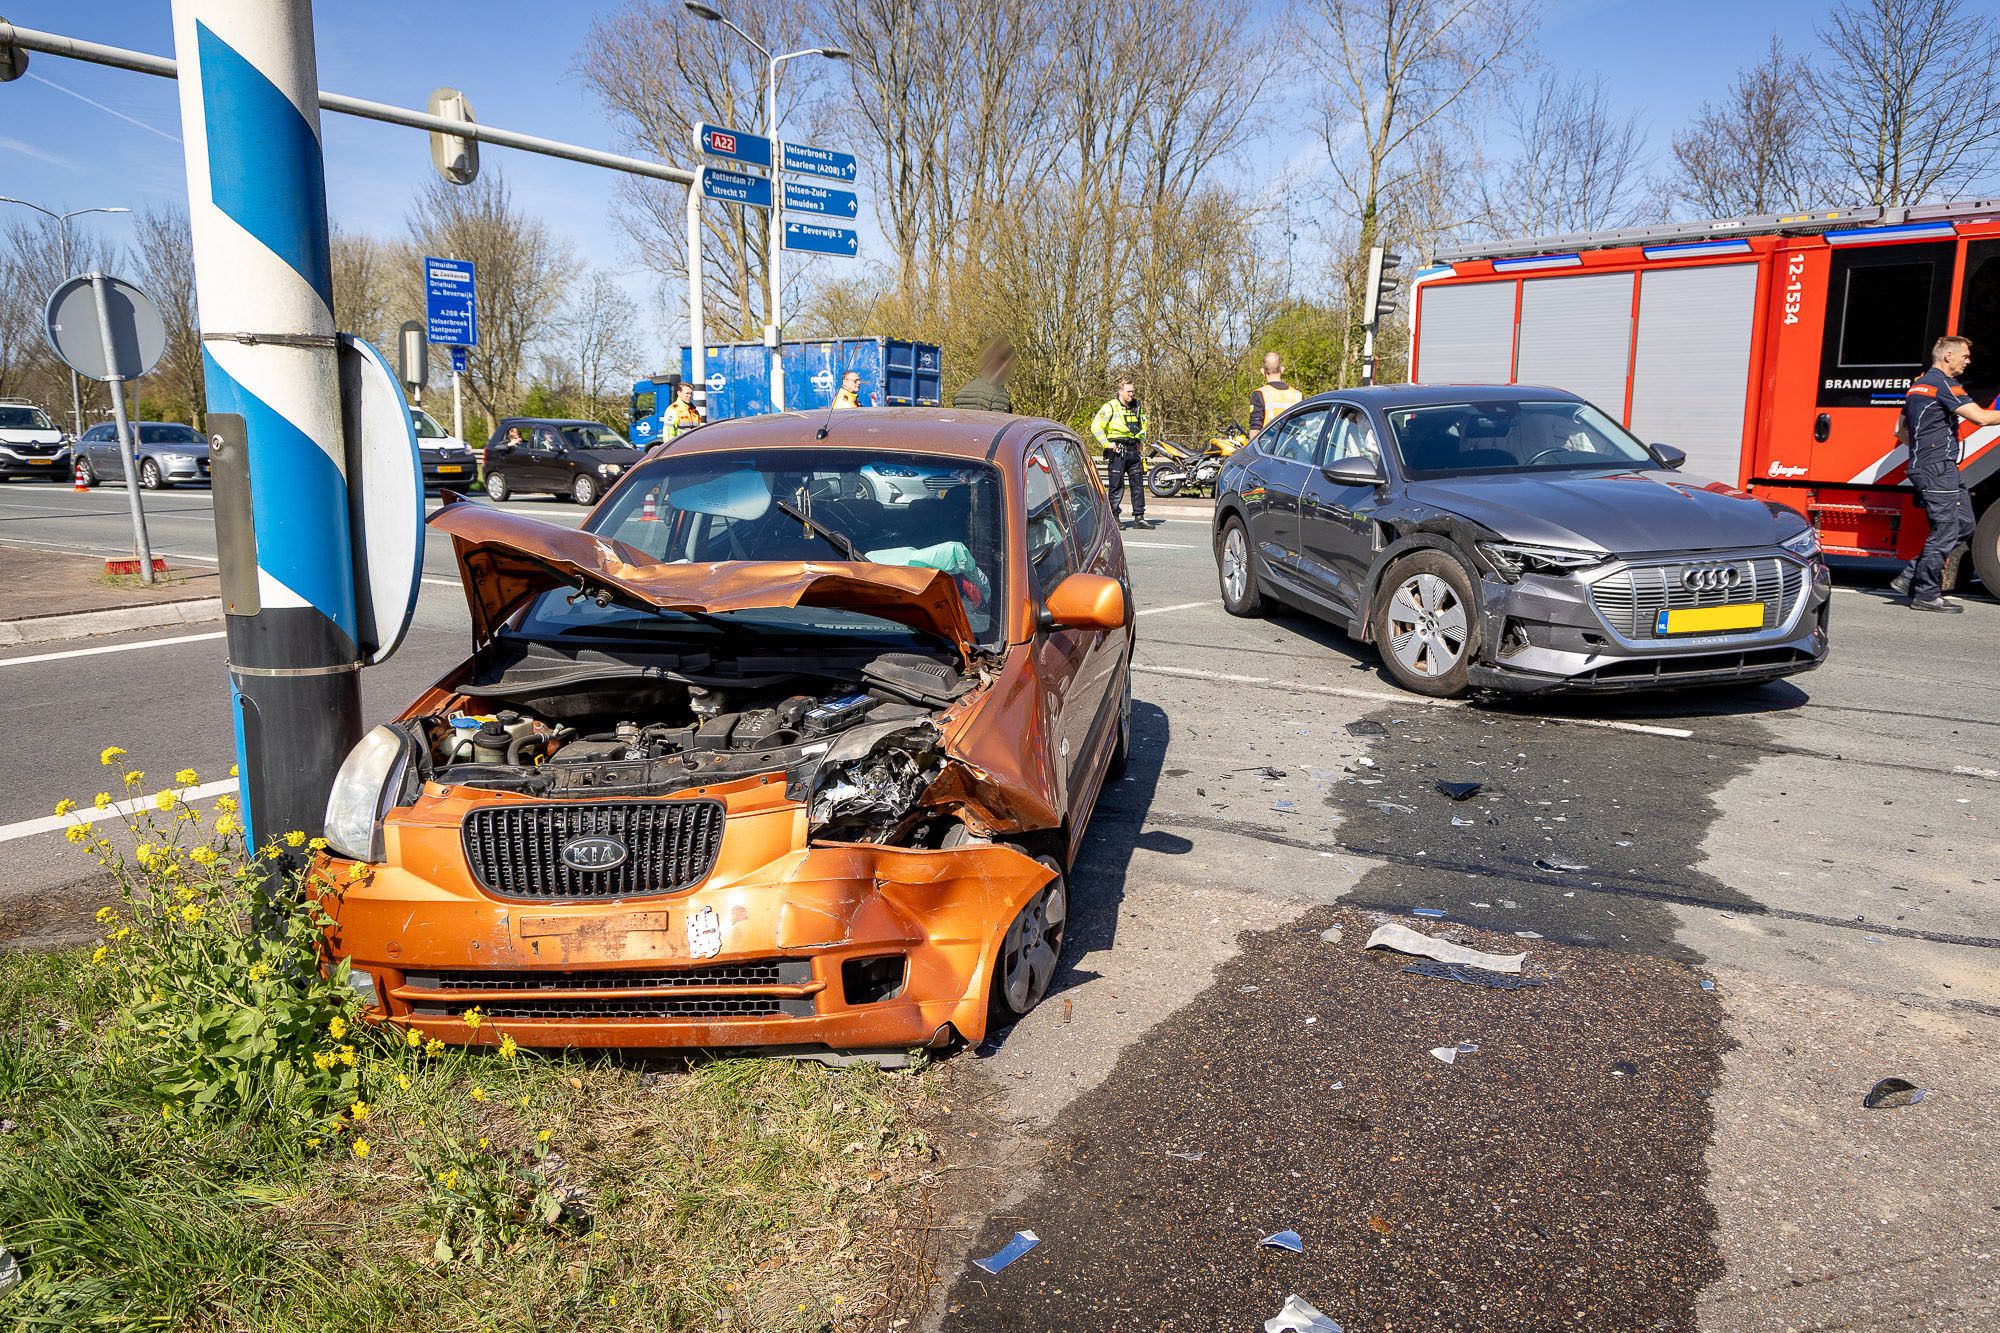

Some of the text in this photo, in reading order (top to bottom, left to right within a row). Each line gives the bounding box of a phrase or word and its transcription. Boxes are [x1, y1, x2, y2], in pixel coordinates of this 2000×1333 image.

[714, 136, 733, 151] A22
[786, 145, 834, 161] Velserbroek 2
[786, 158, 846, 176] Haarlem (A208) 5
[712, 171, 756, 187] Rotterdam 77
[712, 185, 747, 199] Utrecht 57
[786, 184, 827, 198] Velsen-Zuid
[787, 198, 825, 211] IJmuiden 3
[803, 225, 843, 239] Beverwijk 5
[429, 260, 458, 269] IJmuiden
[442, 289, 473, 299] Beverwijk
[1784, 253, 1805, 326] 12-1534
[430, 317, 468, 327] Velserbroek
[430, 326, 463, 334] Santpoort
[1825, 379, 1911, 389] BRANDWEER
[573, 846, 615, 862] KIA
